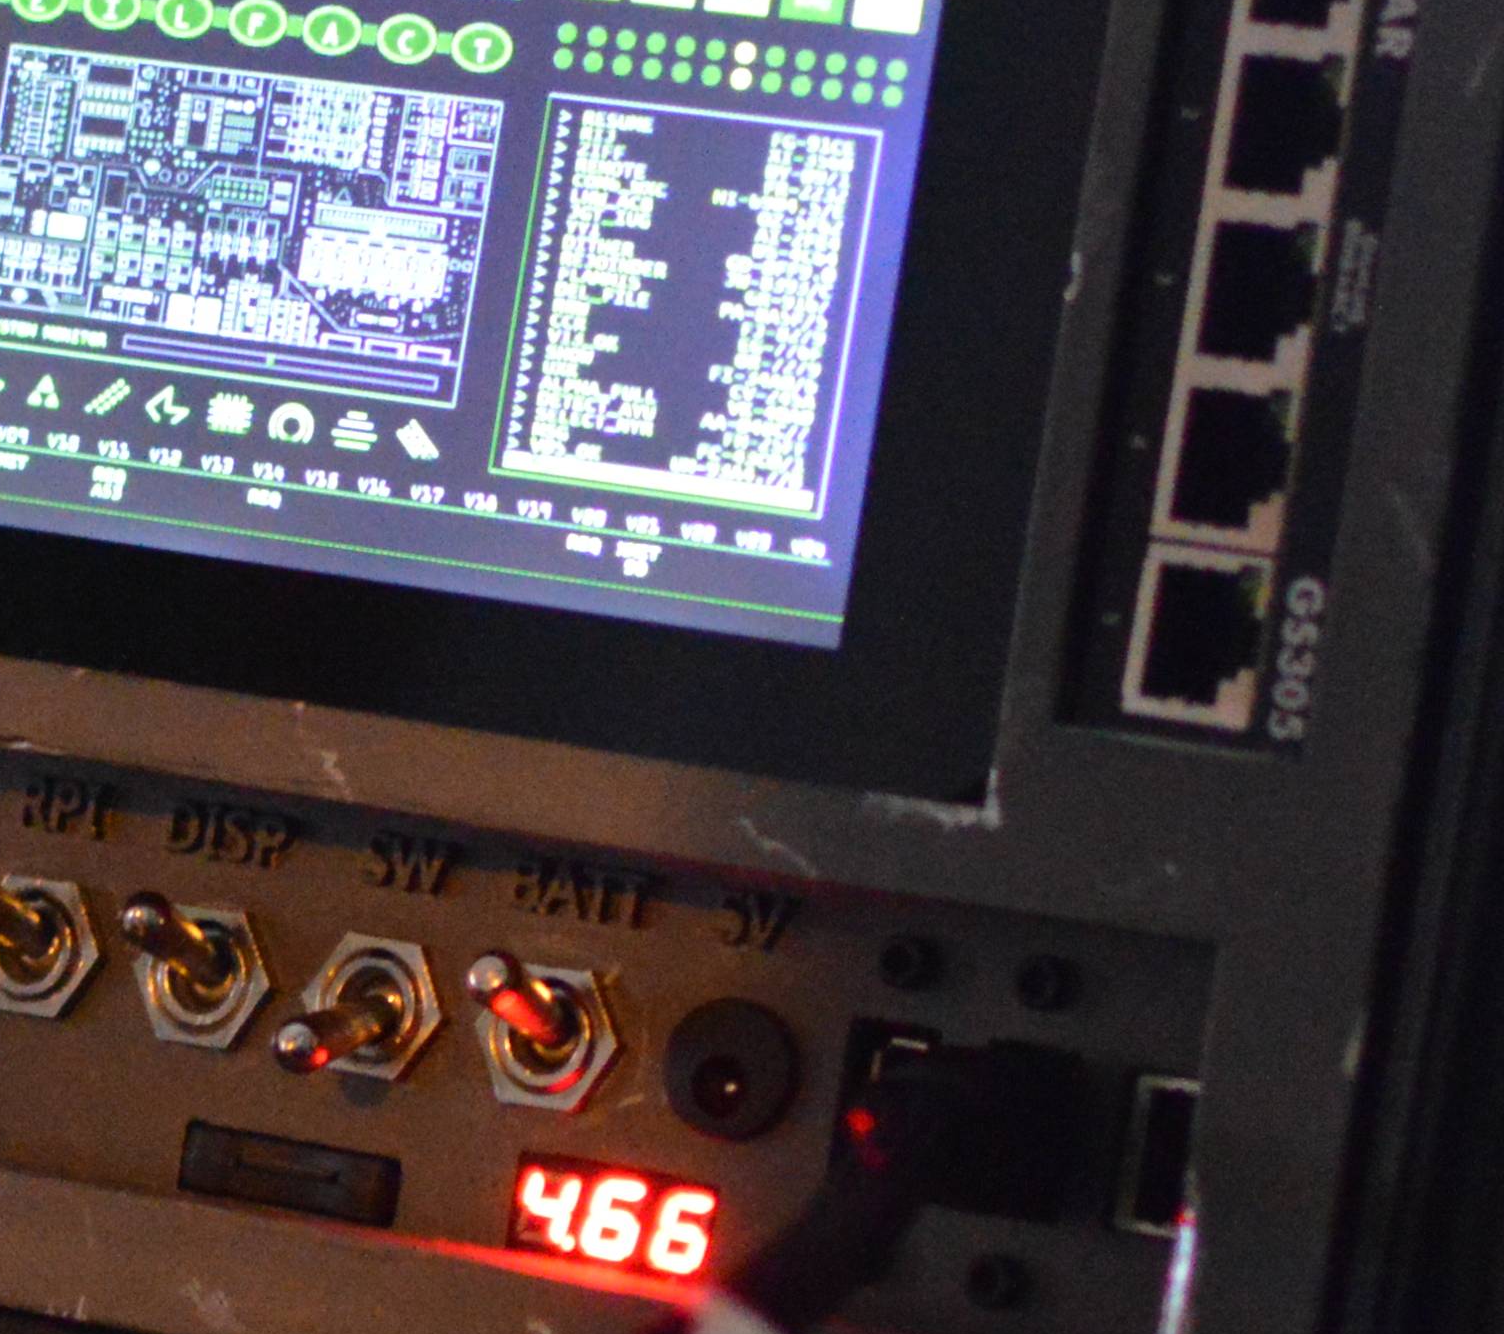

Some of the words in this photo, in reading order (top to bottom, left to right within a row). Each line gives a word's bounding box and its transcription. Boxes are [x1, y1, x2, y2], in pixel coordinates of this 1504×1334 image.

[409, 481, 448, 505] V17
[1267, 575, 1325, 741] GS305
[166, 802, 302, 867] DISP
[368, 829, 467, 895] SW
[512, 855, 660, 929] BATT
[521, 1170, 717, 1275] 4.66
